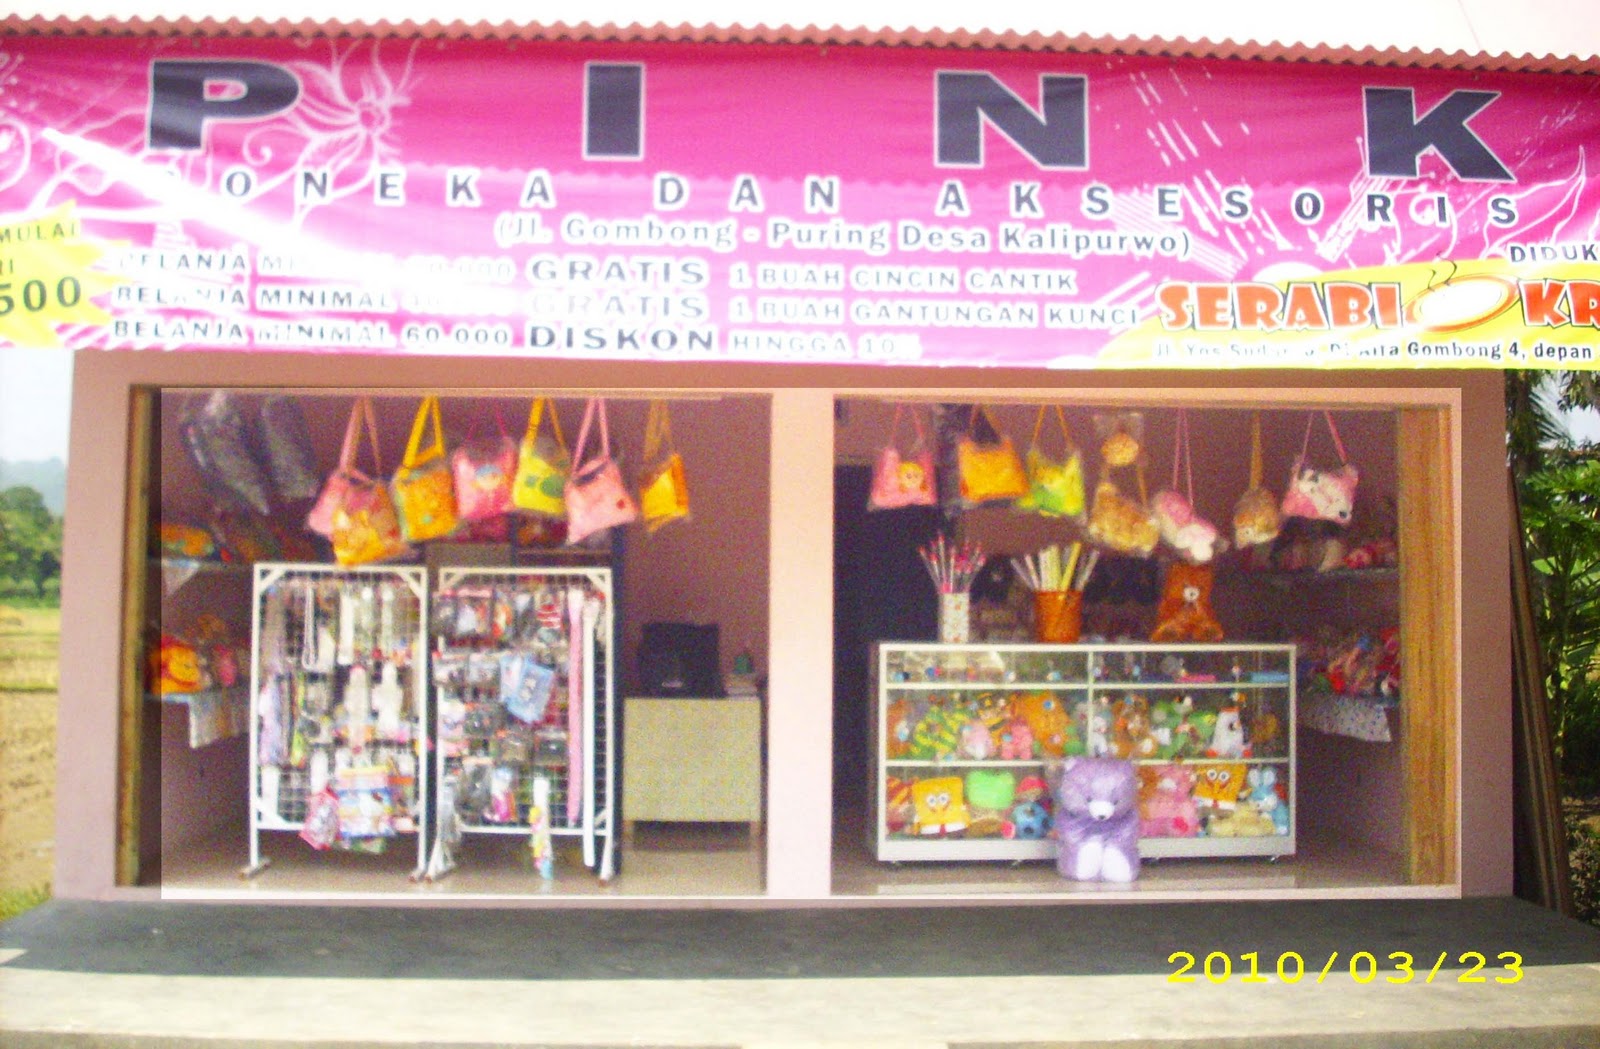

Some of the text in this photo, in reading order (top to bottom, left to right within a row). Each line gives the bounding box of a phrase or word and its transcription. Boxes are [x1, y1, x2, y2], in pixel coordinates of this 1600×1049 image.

[147, 57, 1517, 185] PINK
[166, 168, 1518, 228] ONEKA DAN AKSESORIS
[0, 223, 77, 243] MULAI
[566, 217, 733, 248] Gombong
[772, 221, 888, 251] Puring
[903, 224, 986, 249] Desa
[1004, 227, 1191, 257] Kalipurwo)
[120, 252, 246, 272] ELANJA
[531, 259, 705, 286] GRATIS
[762, 267, 840, 286] BUAH
[855, 270, 956, 288] CINCIN
[970, 272, 1075, 291] CANTIK
[258, 288, 392, 309] MINIMAL
[762, 301, 840, 320] BUAH
[855, 303, 1035, 325] GANTUNGAN
[1048, 307, 1138, 326] KUNCI
[1156, 281, 1402, 333] SERABI
[113, 320, 244, 340] BELANJA
[405, 326, 510, 346] 60000
[529, 325, 714, 351] DISKON
[733, 335, 848, 354] HINGGA
[1406, 341, 1502, 361] Gombong
[1507, 341, 1526, 360] 4,
[1533, 342, 1593, 362] depan
